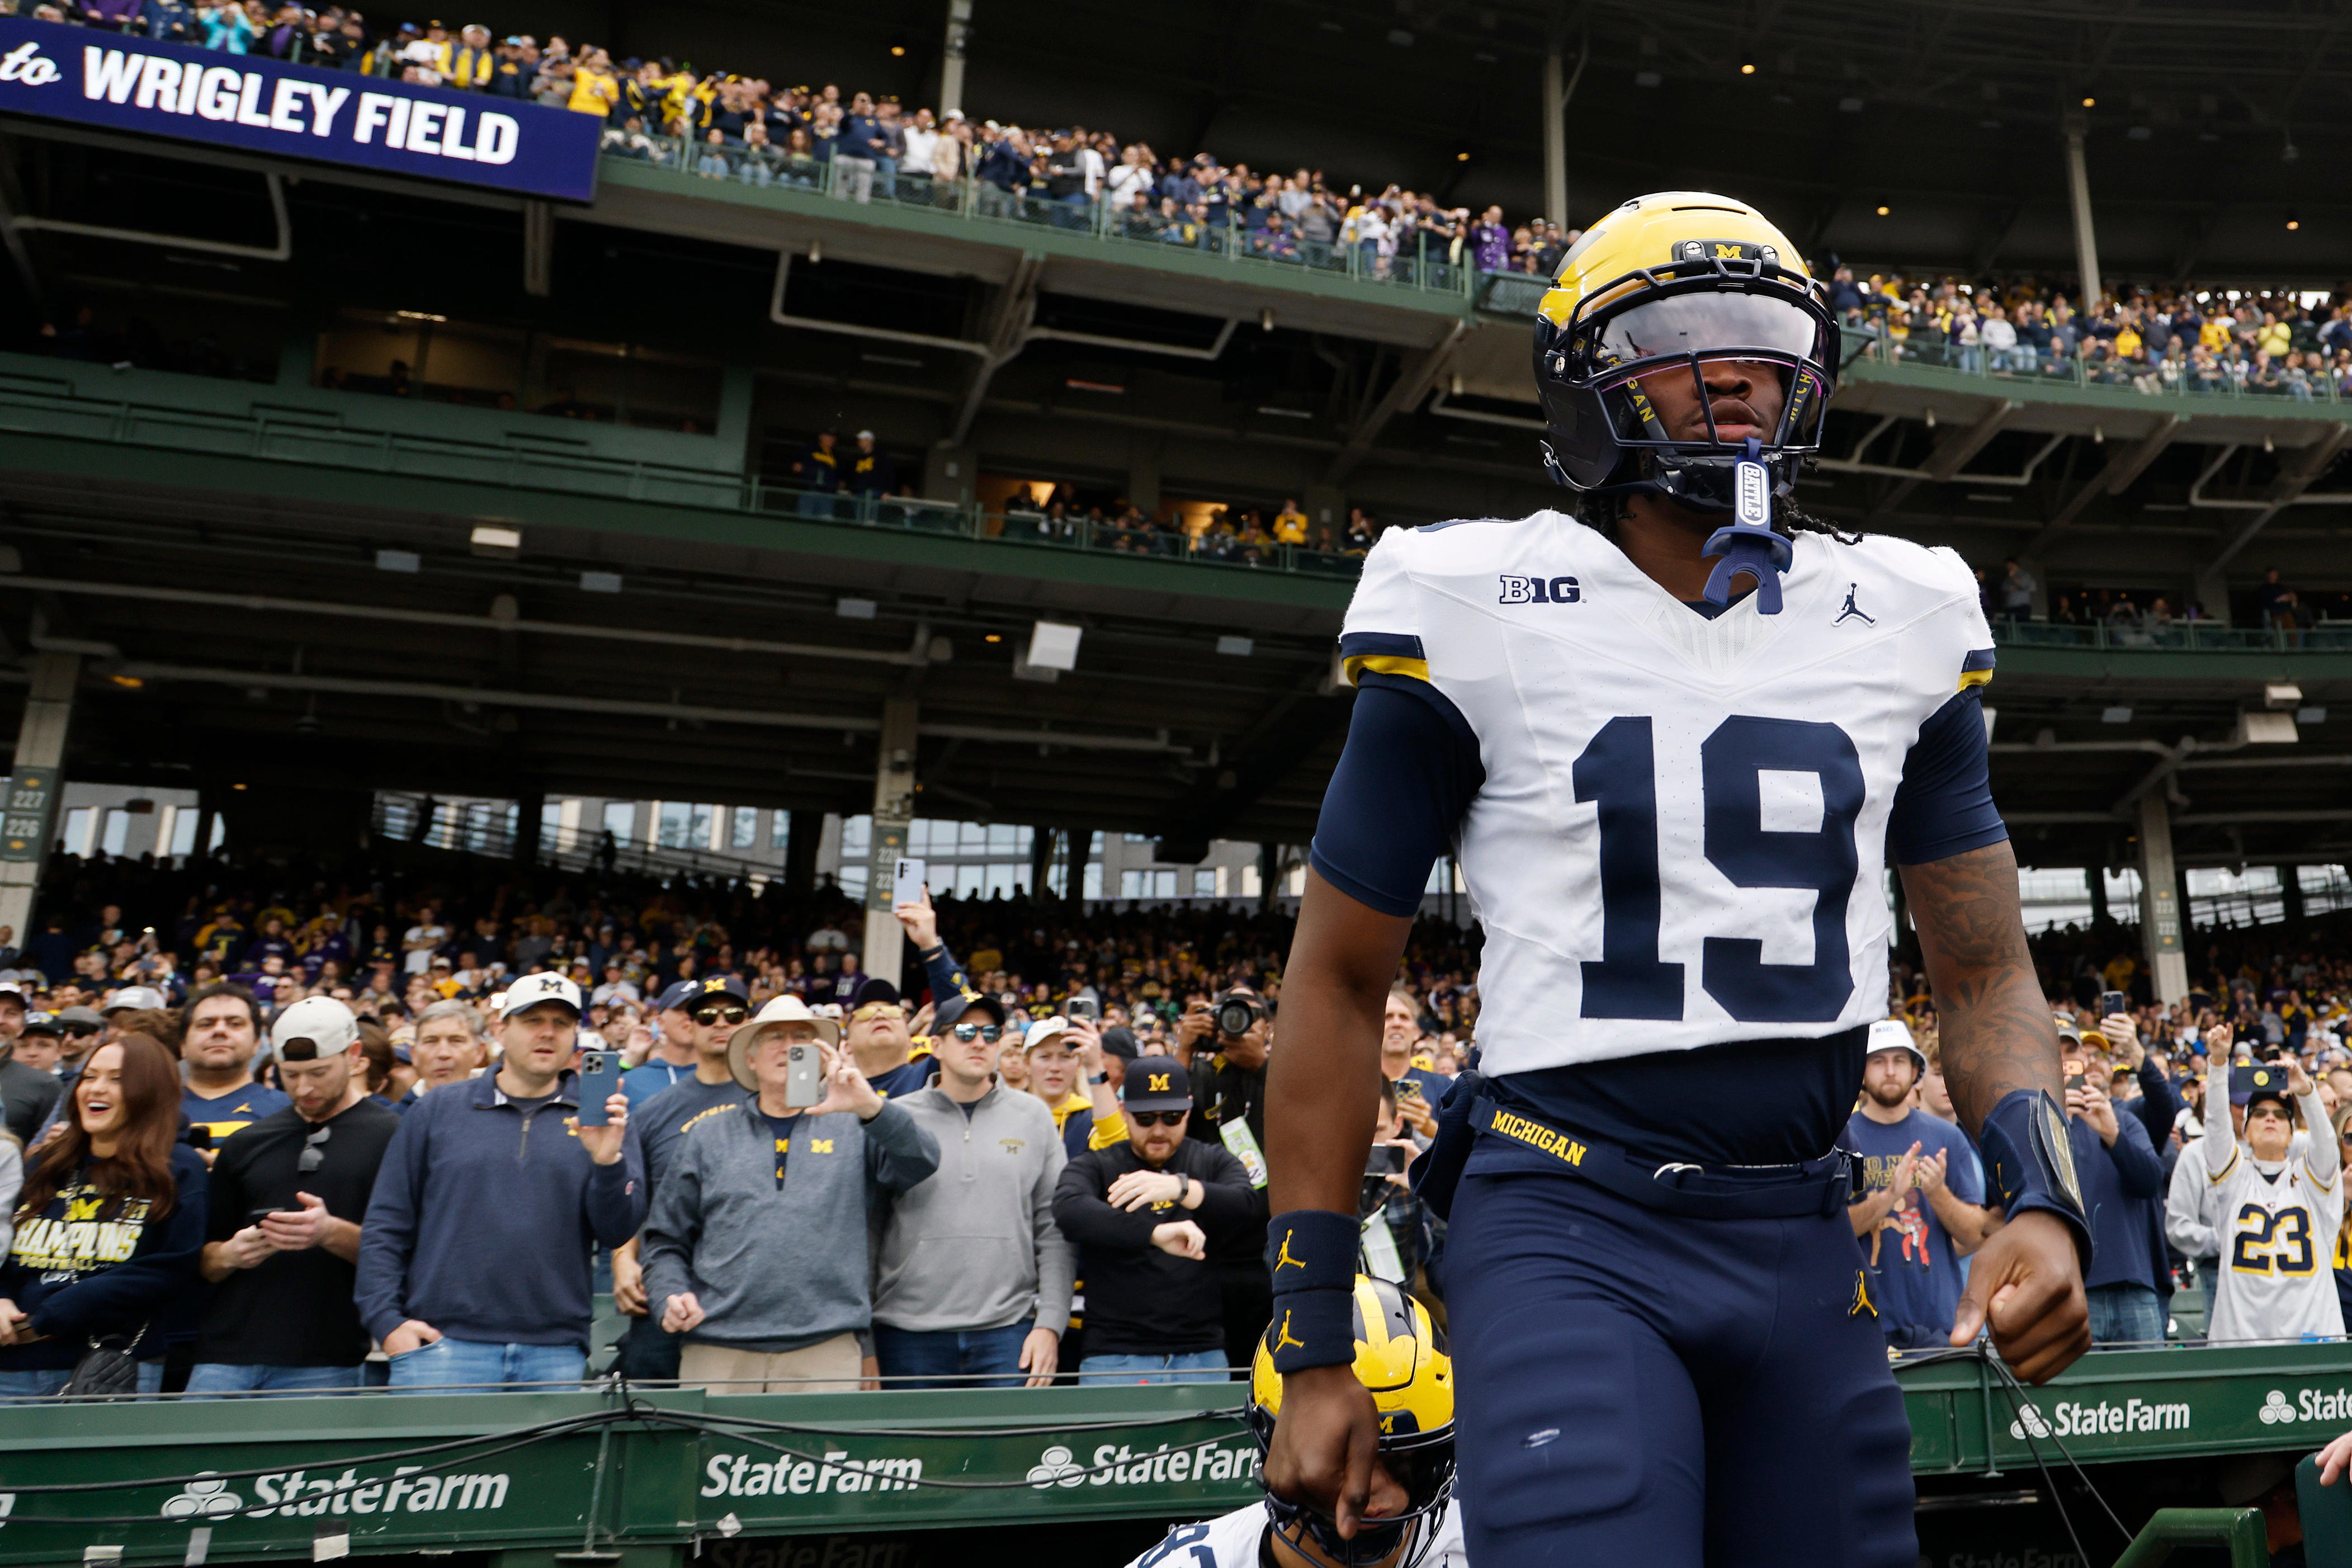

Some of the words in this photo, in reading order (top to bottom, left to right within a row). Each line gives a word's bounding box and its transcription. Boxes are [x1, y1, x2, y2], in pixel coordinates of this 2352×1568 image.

[0, 41, 62, 86] to
[84, 46, 350, 138] WRIGLEY
[353, 91, 519, 165] FIELD
[1715, 244, 1742, 259] M
[1744, 465, 1761, 518] BATTLE
[13, 790, 45, 809] 227
[6, 818, 39, 838] 226
[1572, 714, 1865, 1022] 19
[875, 872, 895, 890] 22
[540, 979, 562, 993] M
[704, 977, 726, 993] M
[1148, 1073, 1170, 1091] M
[811, 1139, 834, 1153] M
[1491, 1110, 1587, 1166] MICHIGAN
[2232, 1203, 2318, 1277] 23
